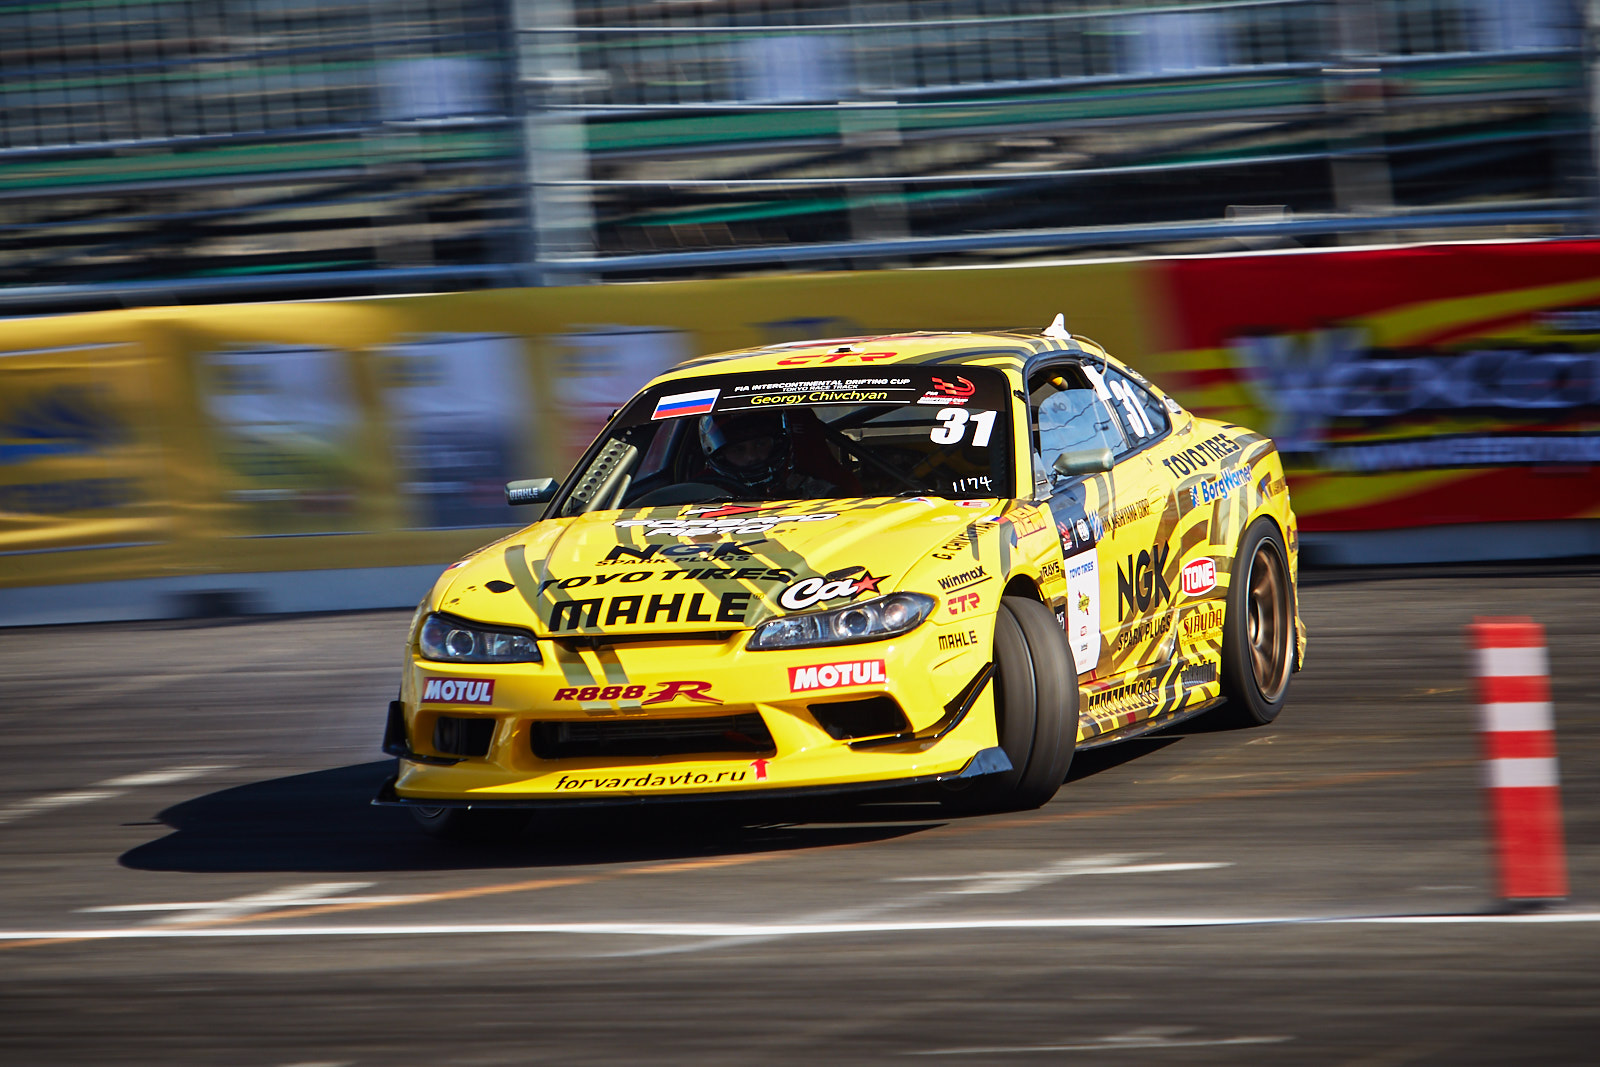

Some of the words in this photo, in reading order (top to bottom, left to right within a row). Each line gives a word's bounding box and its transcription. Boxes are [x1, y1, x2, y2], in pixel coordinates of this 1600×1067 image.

[751, 379, 842, 391] INTERCONTINENTAL
[750, 393, 807, 405] Georgy
[808, 391, 888, 402] Chivchyan
[1109, 379, 1155, 438] 31
[929, 407, 998, 448] 31
[1162, 446, 1207, 478] TOYO
[1196, 433, 1240, 466] TIRES
[509, 487, 539, 498] MAHLE
[952, 476, 993, 492] 1174
[1200, 463, 1252, 505] BorgWarner
[595, 558, 666, 567] SPARK
[670, 554, 754, 563] PLUGS
[604, 539, 769, 561] NGK
[1042, 561, 1060, 578] RAYS
[1069, 566, 1081, 580] TOYO
[1081, 561, 1094, 576] TIRES
[1184, 564, 1214, 590] TONE
[537, 570, 655, 598] TOYO
[655, 567, 798, 583] TIRES
[1116, 540, 1171, 623] NGK
[548, 592, 754, 632] MAHLE
[948, 592, 981, 615] CTR
[938, 630, 978, 651] MAHLE
[1117, 627, 1143, 651] SPARK
[1142, 614, 1171, 642] PLUGS
[792, 661, 886, 690] MOTUL
[424, 679, 491, 702] MOTUL
[553, 684, 647, 703] R888
[553, 767, 747, 791] forvardavto.ru
